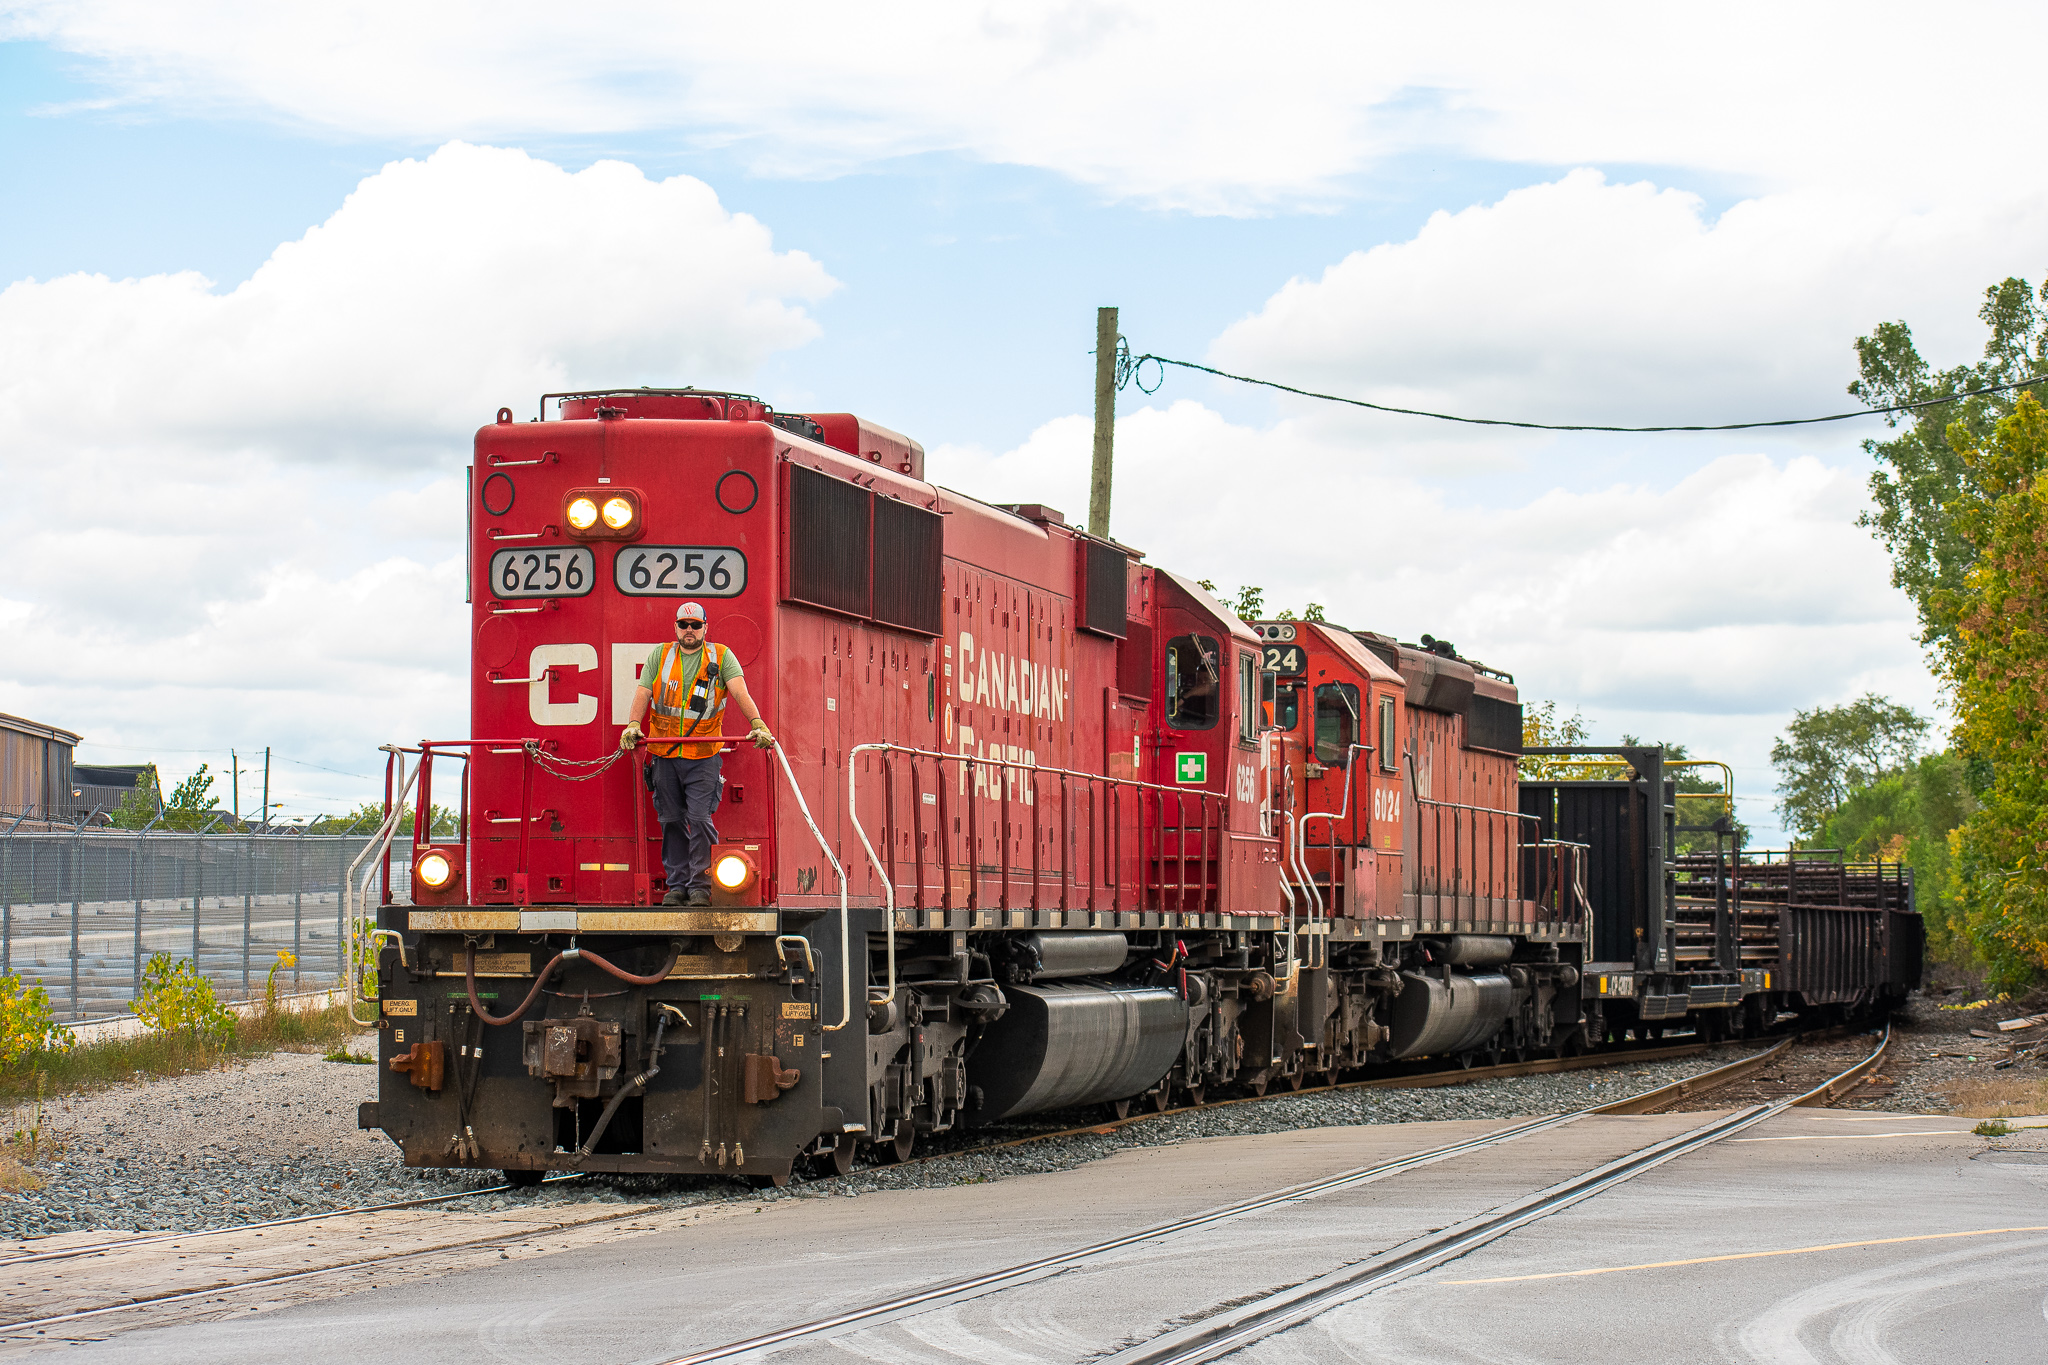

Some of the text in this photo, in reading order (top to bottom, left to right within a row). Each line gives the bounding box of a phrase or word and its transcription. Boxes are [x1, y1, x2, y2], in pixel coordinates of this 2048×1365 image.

[502, 553, 583, 591] 6256
[629, 552, 731, 591] 6256
[959, 631, 1063, 723] CANADIAN
[1260, 648, 1298, 671] 24
[959, 725, 1035, 806] PACIFIC
[1236, 763, 1254, 804] 6256
[1374, 787, 1400, 823] 6024
[396, 1030, 403, 1040] E
